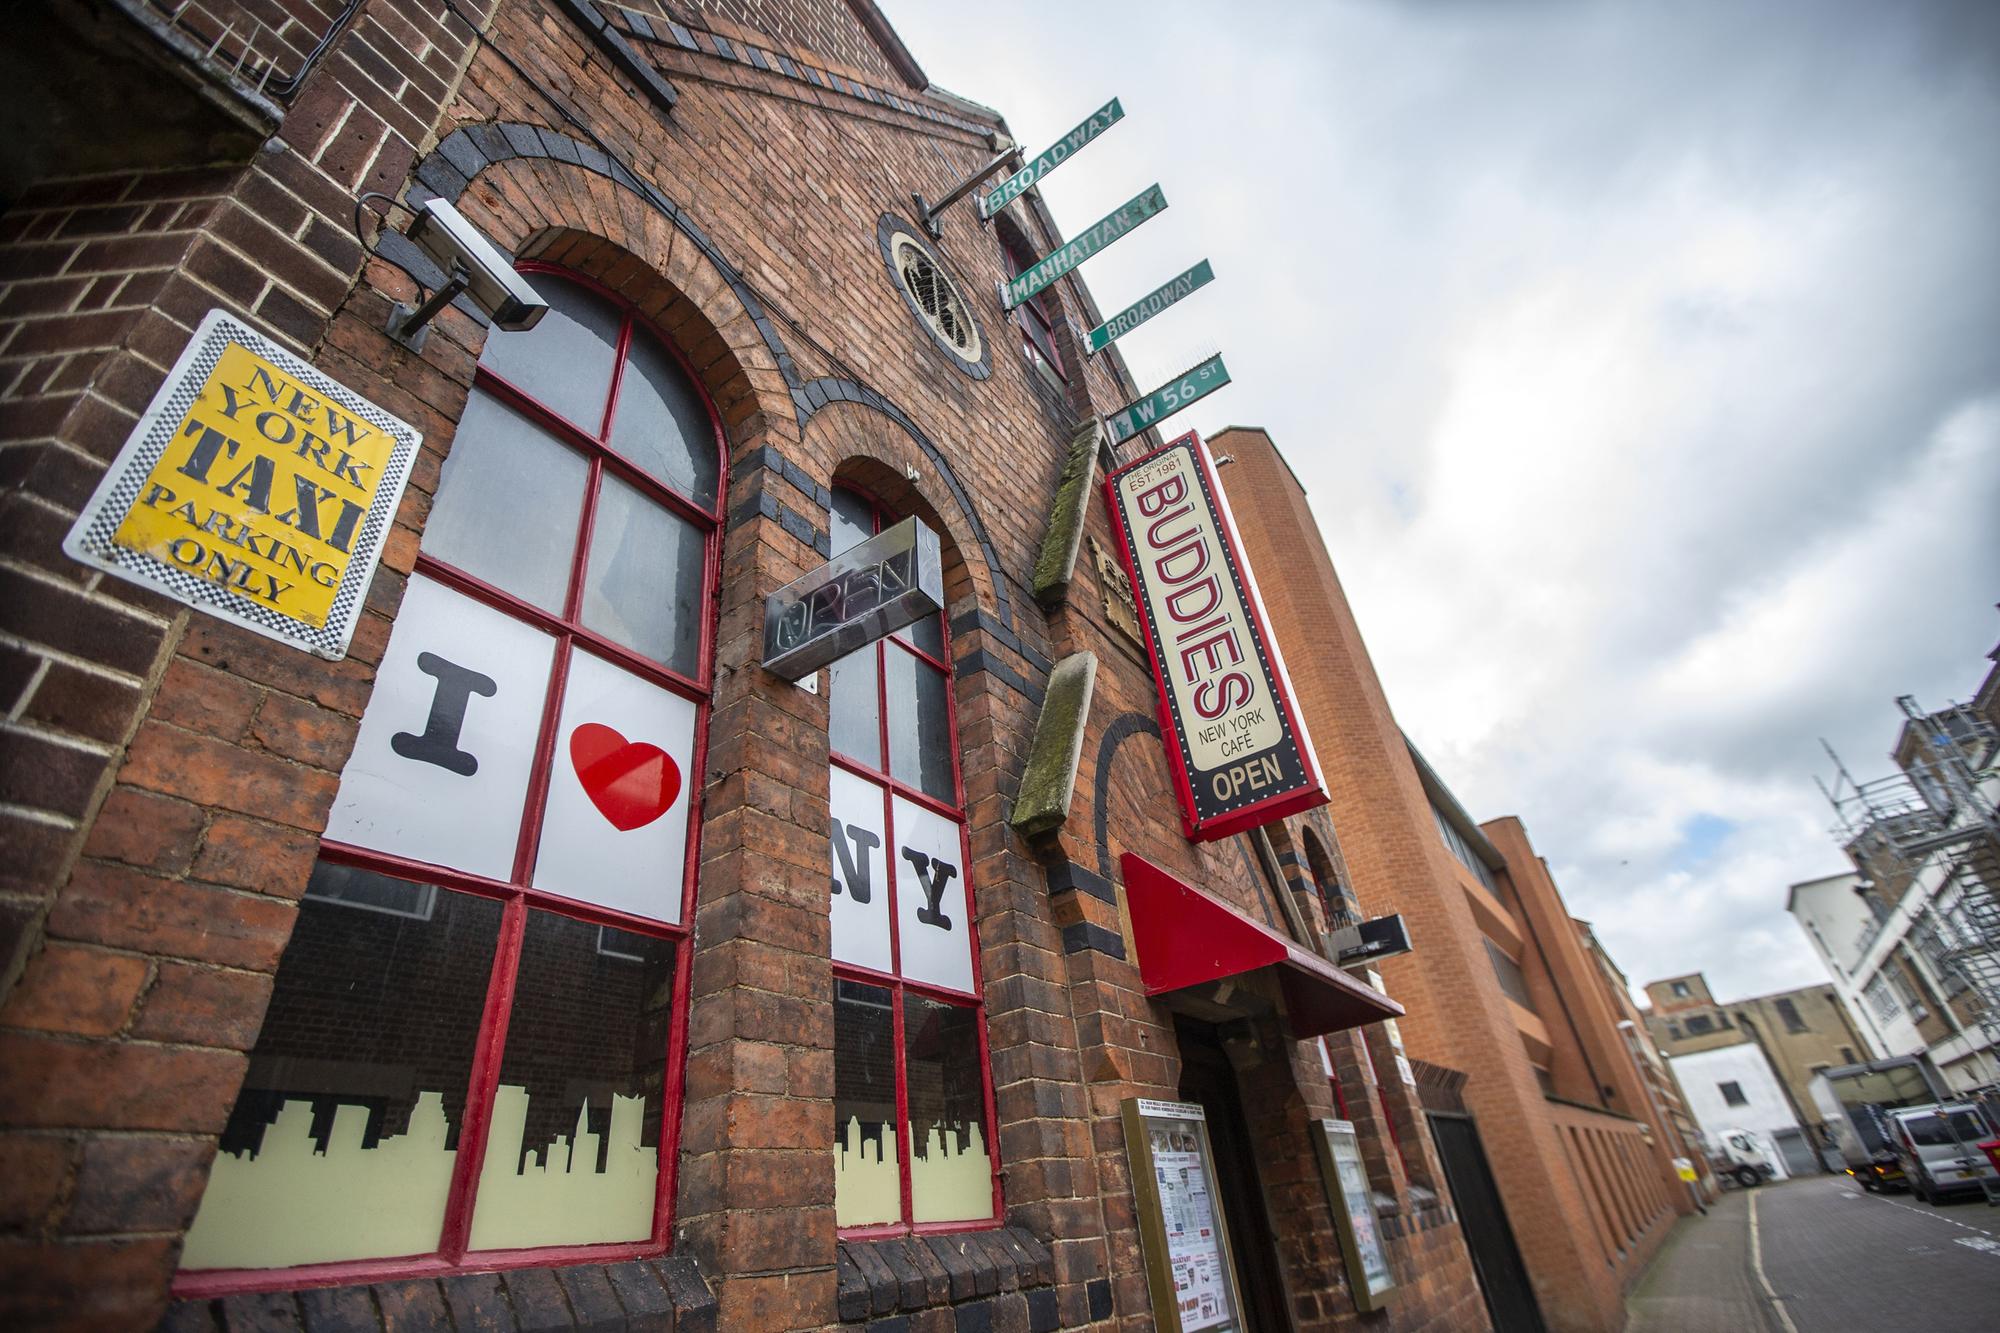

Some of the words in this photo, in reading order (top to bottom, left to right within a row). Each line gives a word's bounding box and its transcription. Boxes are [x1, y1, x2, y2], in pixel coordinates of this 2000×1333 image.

[988, 101, 1119, 212] BROADWAY
[1012, 207, 1132, 303] MANHATTAN
[1105, 271, 1195, 340] BROADWAY
[243, 364, 371, 448] NEW
[1136, 399, 1157, 423] W
[1161, 379, 1197, 410] 56
[1199, 363, 1218, 380] ST
[216, 382, 374, 493] YORK
[1127, 469, 1144, 482] THE
[1143, 451, 1179, 473] ORIGINAL
[1128, 474, 1155, 492] EST.
[1155, 457, 1183, 477] 1981
[176, 419, 366, 555] TAXI
[141, 483, 340, 589] PARKING
[168, 538, 296, 605] ONLY
[776, 545, 915, 650] OPEN
[1136, 471, 1255, 722] BUDDIES
[390, 651, 498, 777] I
[1198, 722, 1227, 746] NEW
[1228, 707, 1266, 733] YORK
[1221, 730, 1255, 757] CAFÉ
[1212, 752, 1284, 801] OPEN
